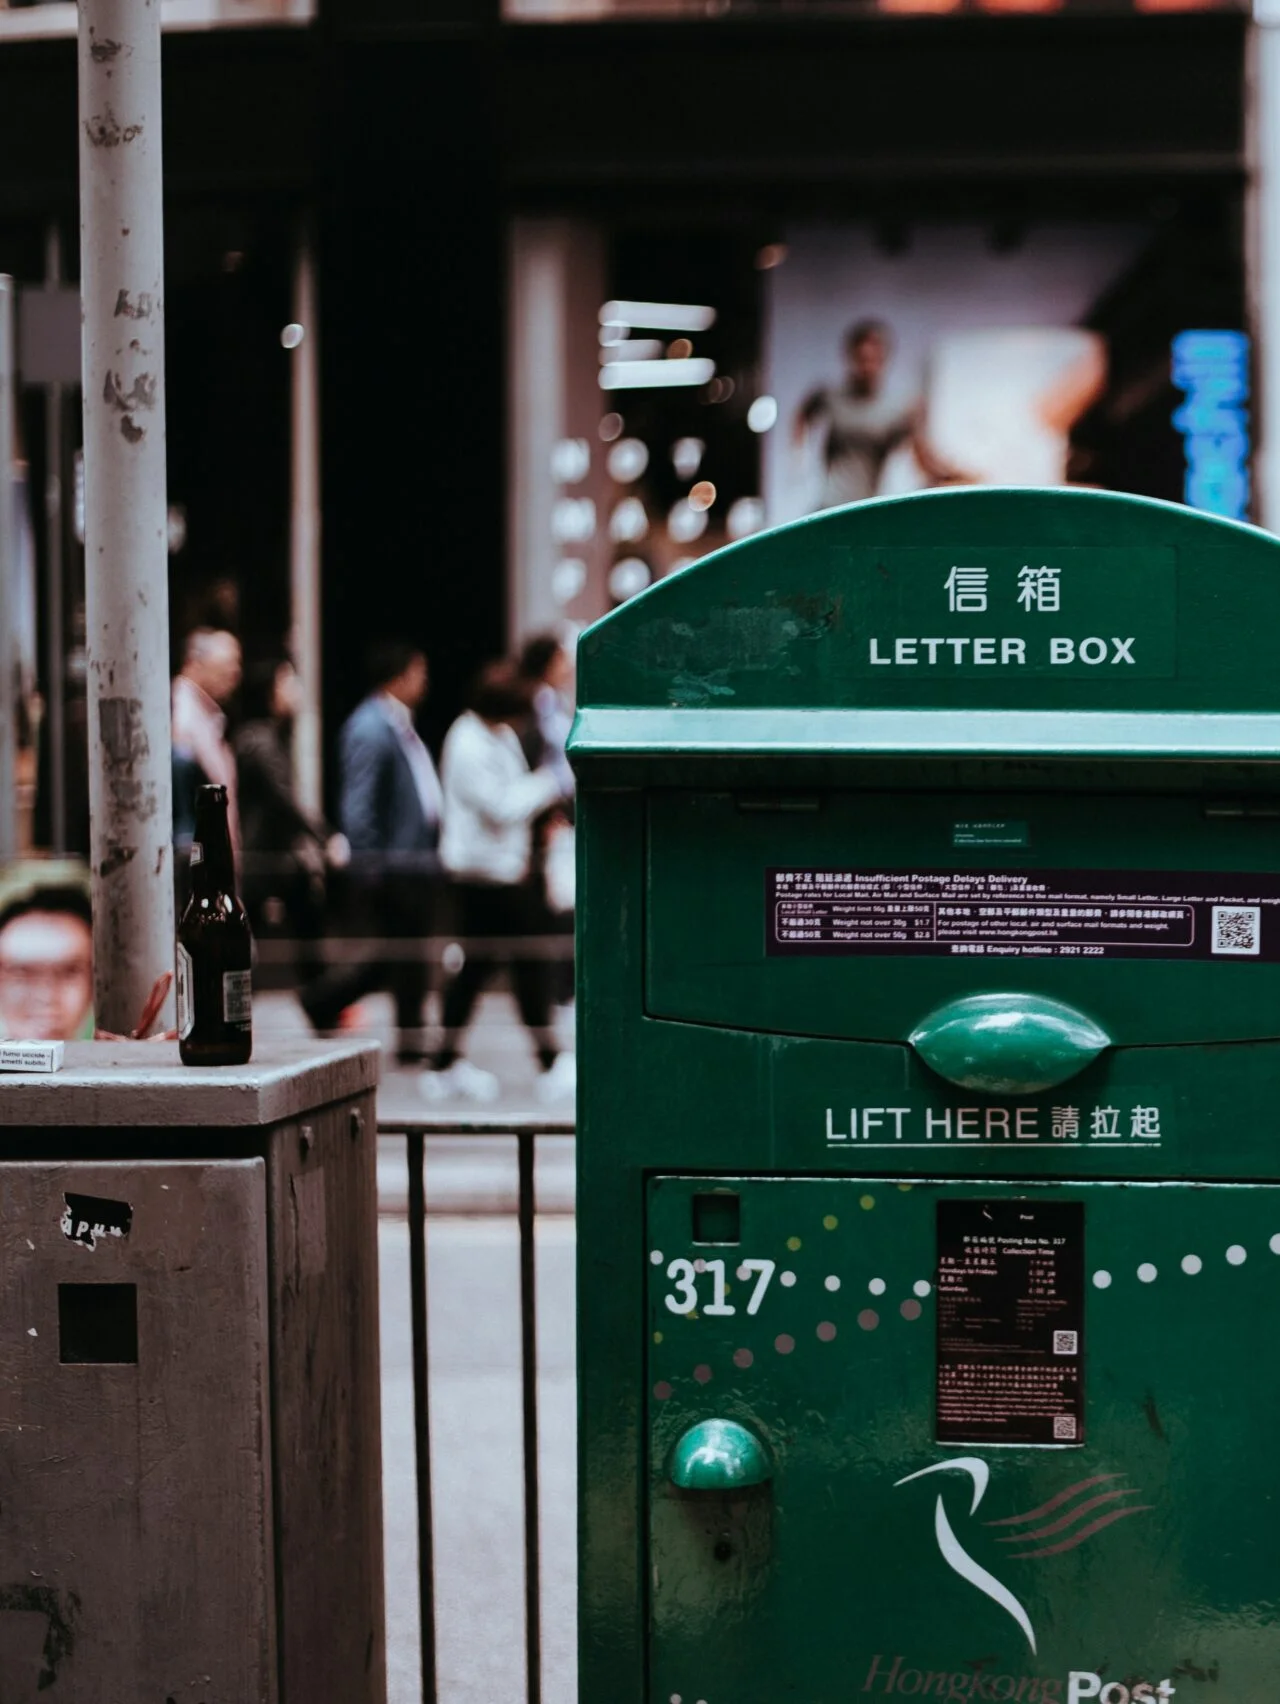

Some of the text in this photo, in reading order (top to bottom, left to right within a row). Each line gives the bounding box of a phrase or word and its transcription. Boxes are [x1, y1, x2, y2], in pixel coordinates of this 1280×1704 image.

[944, 565, 1061, 613] 信箱
[869, 637, 1136, 666] LETTER BOX
[855, 874, 909, 882] Insufficient
[911, 874, 951, 884] Postage
[953, 874, 987, 884] Delays
[988, 874, 1028, 884] Delivery
[832, 905, 856, 913] Weight
[832, 919, 859, 927] Weight
[914, 919, 930, 927] $1.7
[951, 920, 979, 929] postage
[832, 931, 859, 940] Weight
[914, 931, 931, 939] $2.8
[938, 929, 960, 937] please
[986, 945, 1021, 955] Enquiry
[1021, 945, 1052, 953] hotline
[1060, 946, 1081, 954] 2921
[1082, 946, 1105, 954] 2222
[825, 1105, 1161, 1140] LIFT HERE 請拉起
[997, 1236, 1023, 1245] Posting
[664, 1258, 776, 1316] 317
[861, 1653, 1176, 1704] Hongkong Post
